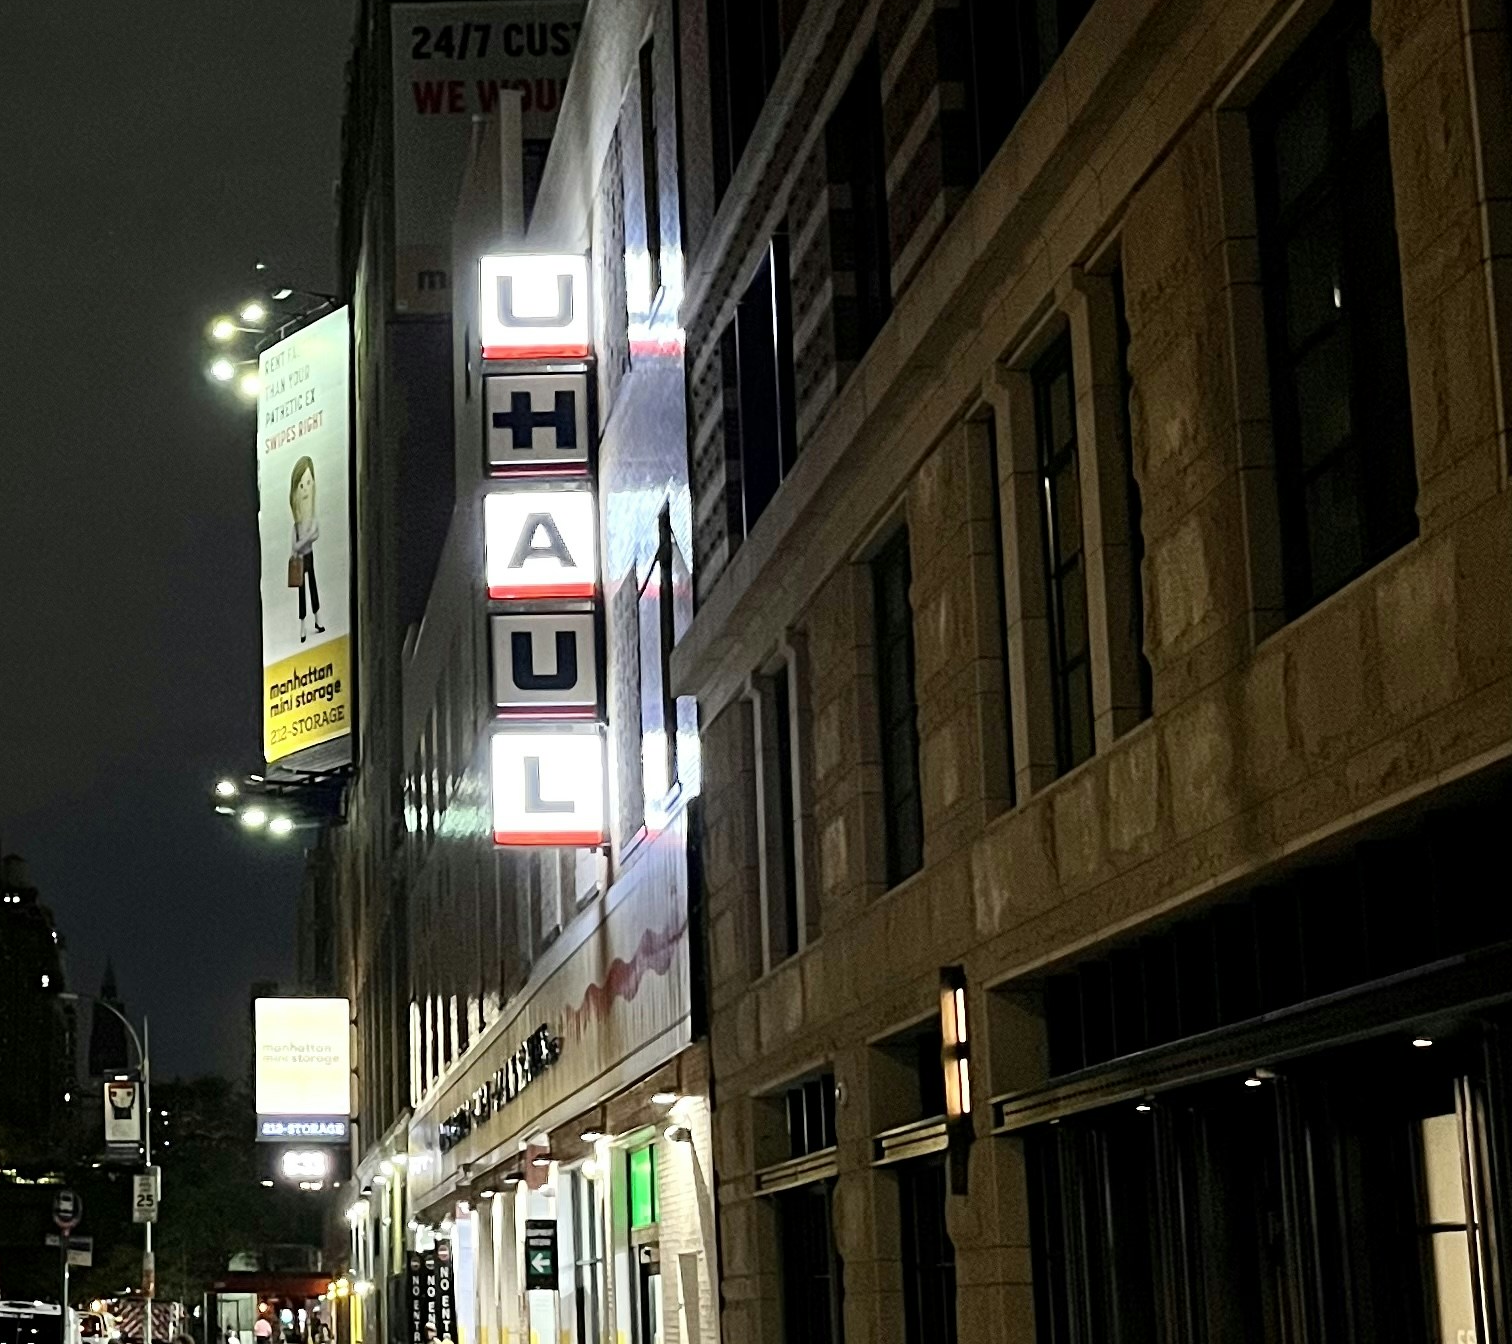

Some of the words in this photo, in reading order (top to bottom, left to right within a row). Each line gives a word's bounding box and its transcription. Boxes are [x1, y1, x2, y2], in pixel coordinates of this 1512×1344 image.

[412, 23, 492, 60] 24/7
[413, 79, 466, 114] WE
[265, 424, 297, 454] SWIPES
[298, 409, 324, 437] RIGHT
[270, 662, 333, 700] manhattan
[270, 696, 293, 718] mini
[296, 679, 341, 708] storage
[262, 1041, 332, 1053] manhattan
[291, 1054, 339, 1066] storage
[136, 1195, 154, 1208] 25
[412, 1275, 420, 1297] NO
[427, 1275, 436, 1298] NO
[440, 1266, 450, 1291] NO
